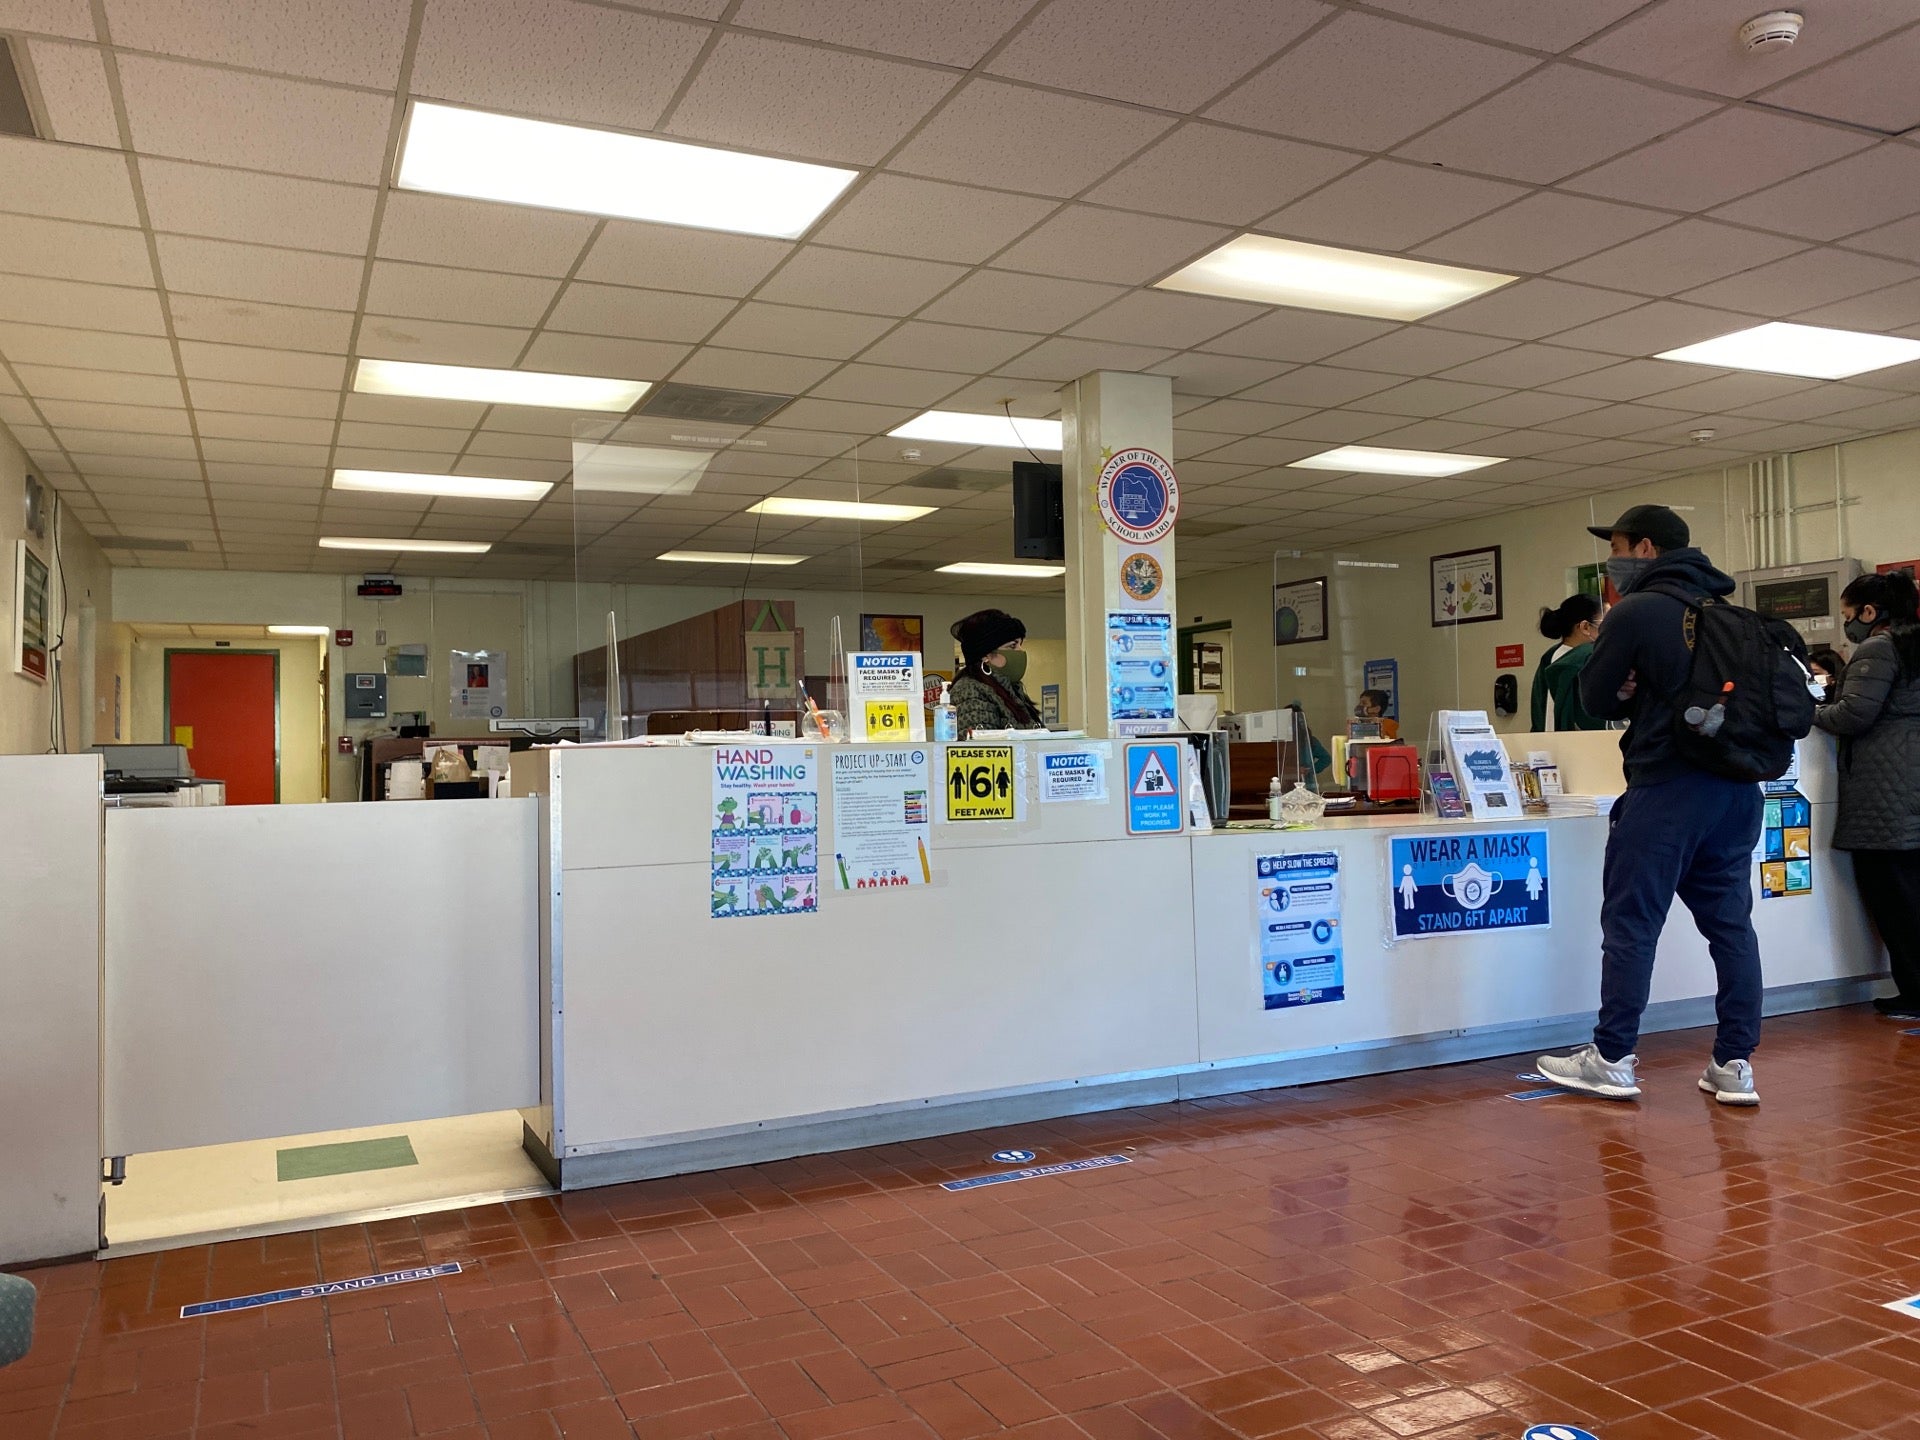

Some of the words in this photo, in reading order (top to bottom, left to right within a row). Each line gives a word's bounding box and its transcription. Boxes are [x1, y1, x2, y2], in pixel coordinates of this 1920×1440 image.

[1101, 454, 1126, 489] WINNER
[1127, 451, 1140, 462] OF
[1141, 452, 1159, 468] THE
[1158, 464, 1164, 472] 5
[1162, 470, 1176, 496] STAR
[1107, 516, 1142, 540] SCHOOL
[1142, 520, 1170, 541] AWARD
[752, 646, 791, 688] H
[862, 657, 908, 666] NOTICE
[750, 722, 776, 730] HAD
[882, 713, 893, 727] 6
[751, 729, 791, 737] WAHING
[1125, 725, 1162, 734] NOTICE
[716, 749, 774, 764] HAND
[950, 750, 984, 758] PLEASE
[986, 749, 1009, 758] STAY
[835, 754, 867, 770] PROJECT
[869, 752, 907, 768] UP-START
[1051, 755, 1091, 767] NOTICE
[716, 764, 806, 781] WASHING
[969, 766, 992, 798] 6
[955, 808, 977, 816] FEET
[979, 807, 1006, 816] AWAY
[1140, 818, 1171, 826] PROGRESS
[715, 837, 721, 846] 3
[1410, 839, 1461, 862] WEAR
[1466, 838, 1478, 859] A
[1483, 835, 1531, 858] MASK
[1272, 860, 1287, 870] HELP
[1287, 859, 1302, 868] SLOW
[1303, 859, 1313, 868] THE
[714, 879, 721, 887] 6
[1418, 912, 1461, 930] STAND
[1465, 910, 1485, 927] 6FT
[1488, 906, 1528, 925] APART
[955, 1173, 1016, 1188] PLEASE
[1019, 1164, 1072, 1177] STAND
[1073, 1157, 1118, 1168] HERE
[200, 1291, 292, 1313] PLEASE
[301, 1278, 377, 1297] STAND
[384, 1266, 447, 1283] HERE
